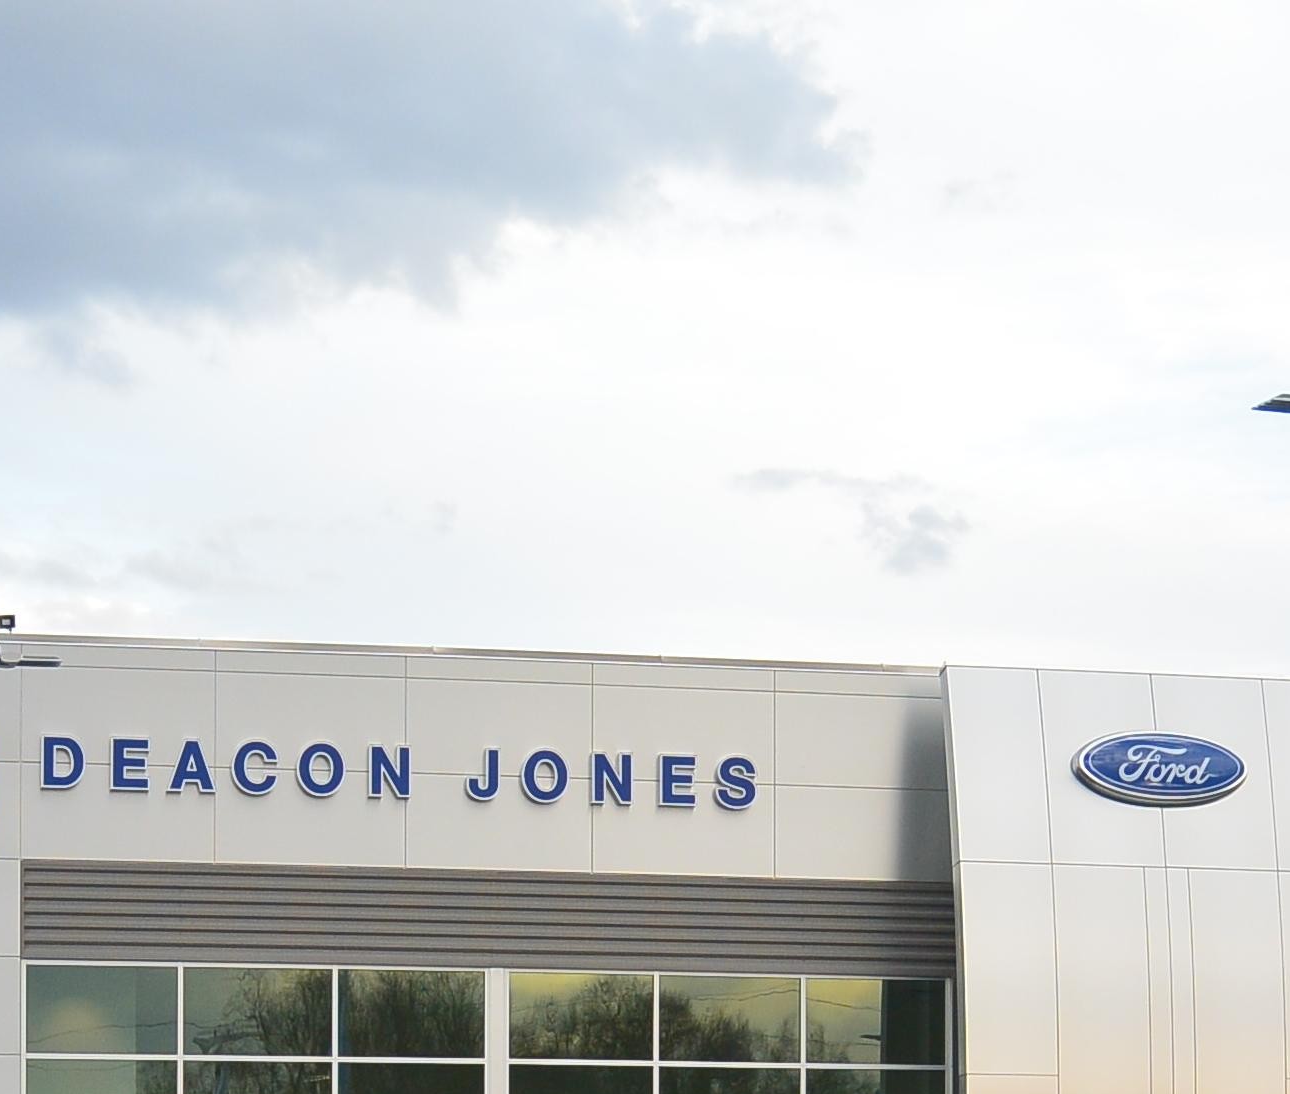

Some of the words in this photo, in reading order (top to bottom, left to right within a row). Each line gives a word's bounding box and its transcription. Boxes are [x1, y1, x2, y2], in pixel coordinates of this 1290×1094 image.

[40, 736, 412, 798] DEACON
[466, 749, 758, 810] JONES
[1118, 744, 1211, 785] Ford
